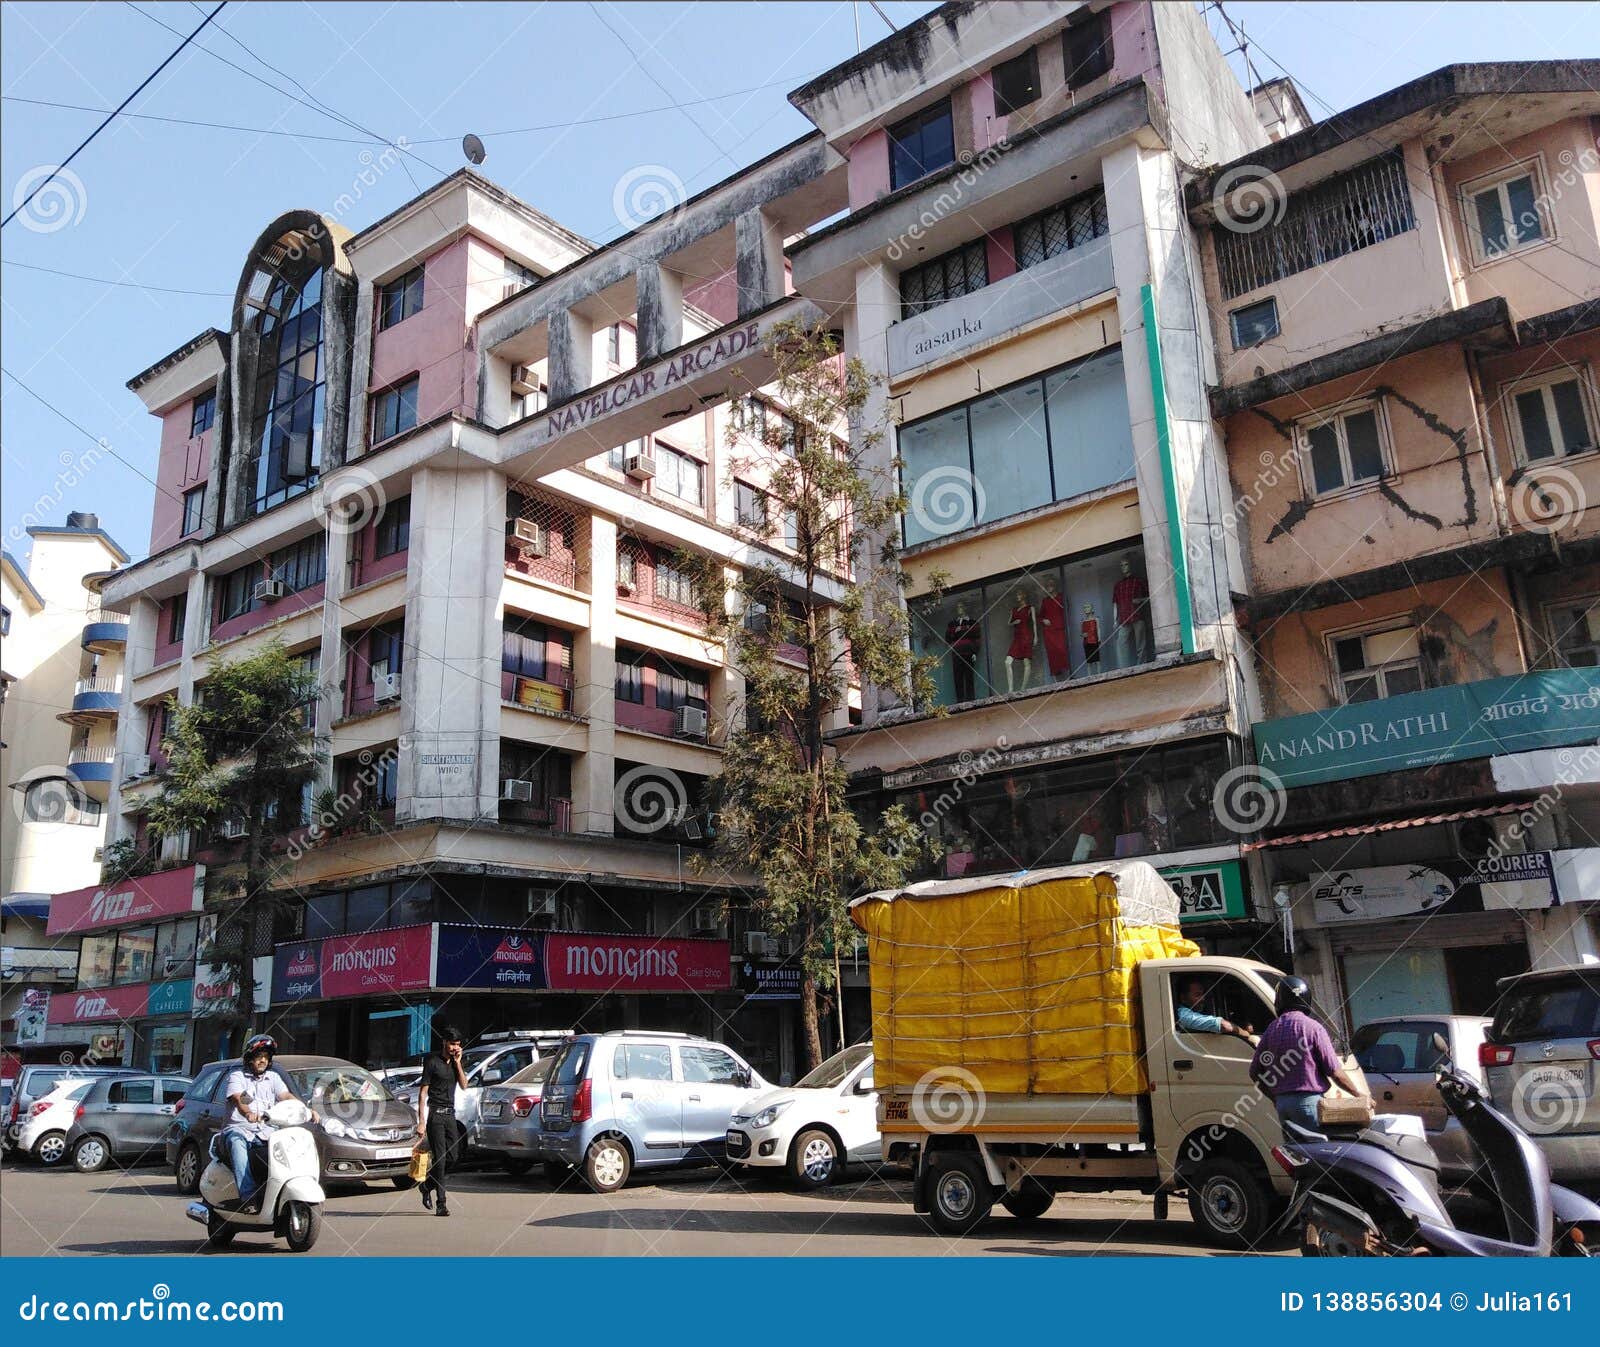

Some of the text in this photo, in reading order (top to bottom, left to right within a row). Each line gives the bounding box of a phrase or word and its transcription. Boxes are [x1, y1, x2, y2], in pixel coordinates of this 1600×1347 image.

[914, 318, 983, 355] aasanka
[547, 322, 760, 437] NAVELCAR ARCADE
[1477, 853, 1548, 874] COURIER
[1496, 868, 1550, 881] INTERNATIONAL
[1315, 885, 1364, 899] BLITS
[704, 967, 722, 979] Shop
